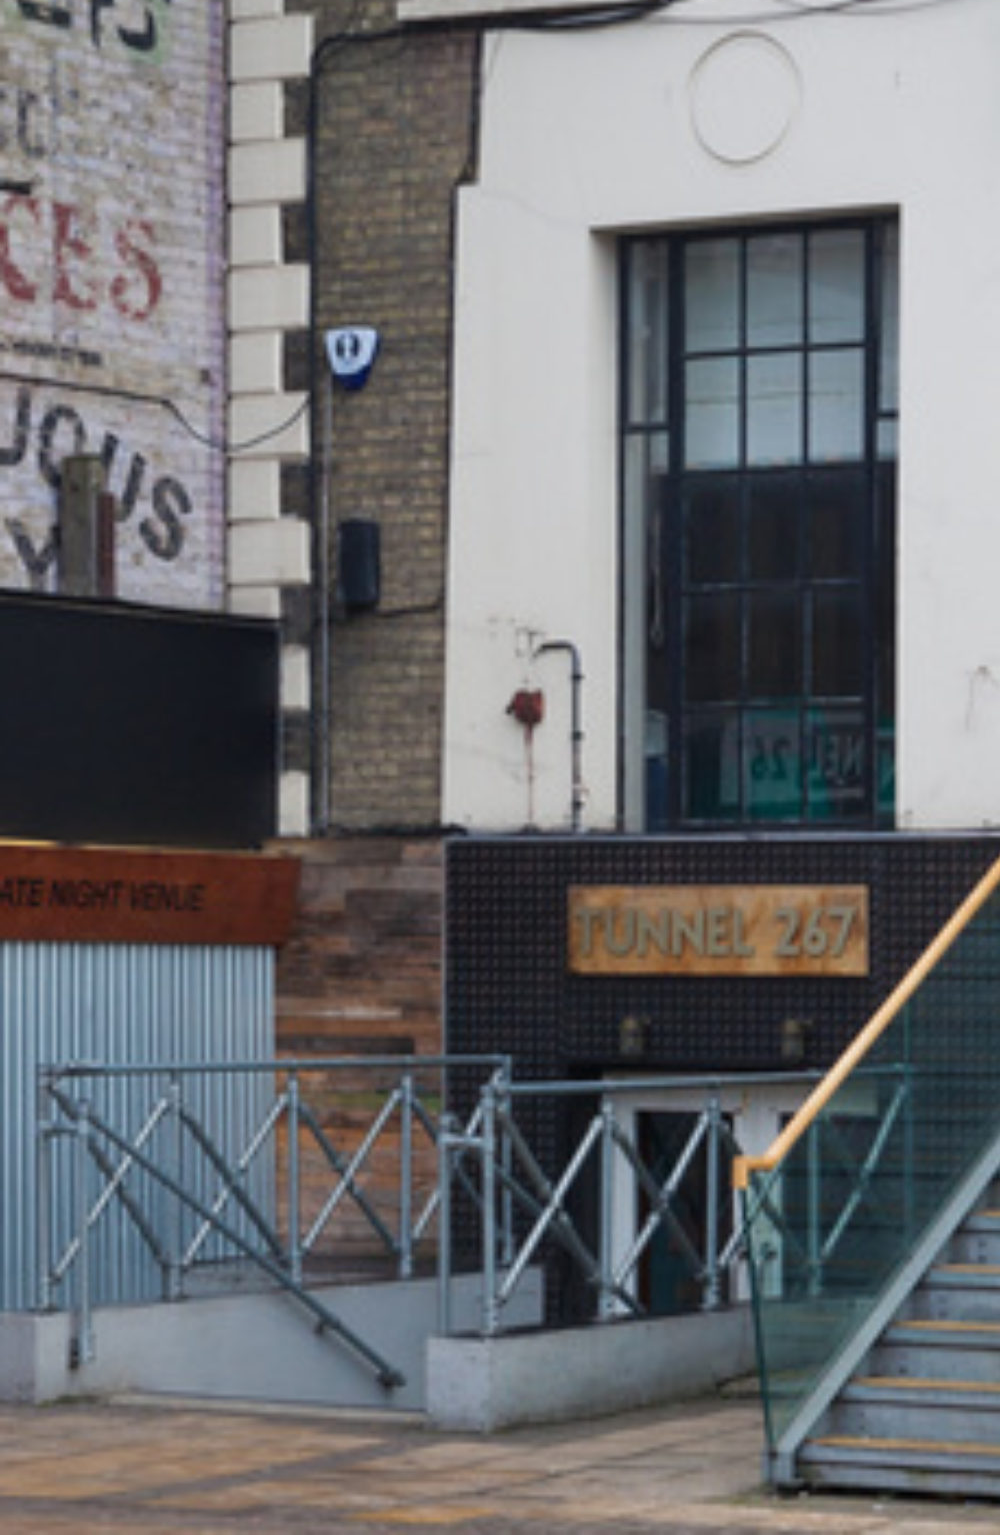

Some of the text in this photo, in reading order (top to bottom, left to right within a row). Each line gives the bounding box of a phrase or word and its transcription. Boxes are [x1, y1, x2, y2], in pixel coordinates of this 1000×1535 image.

[49, 878, 124, 910] NIGHT
[130, 880, 206, 912] VENUE
[574, 904, 859, 957] TUNNEL 267
